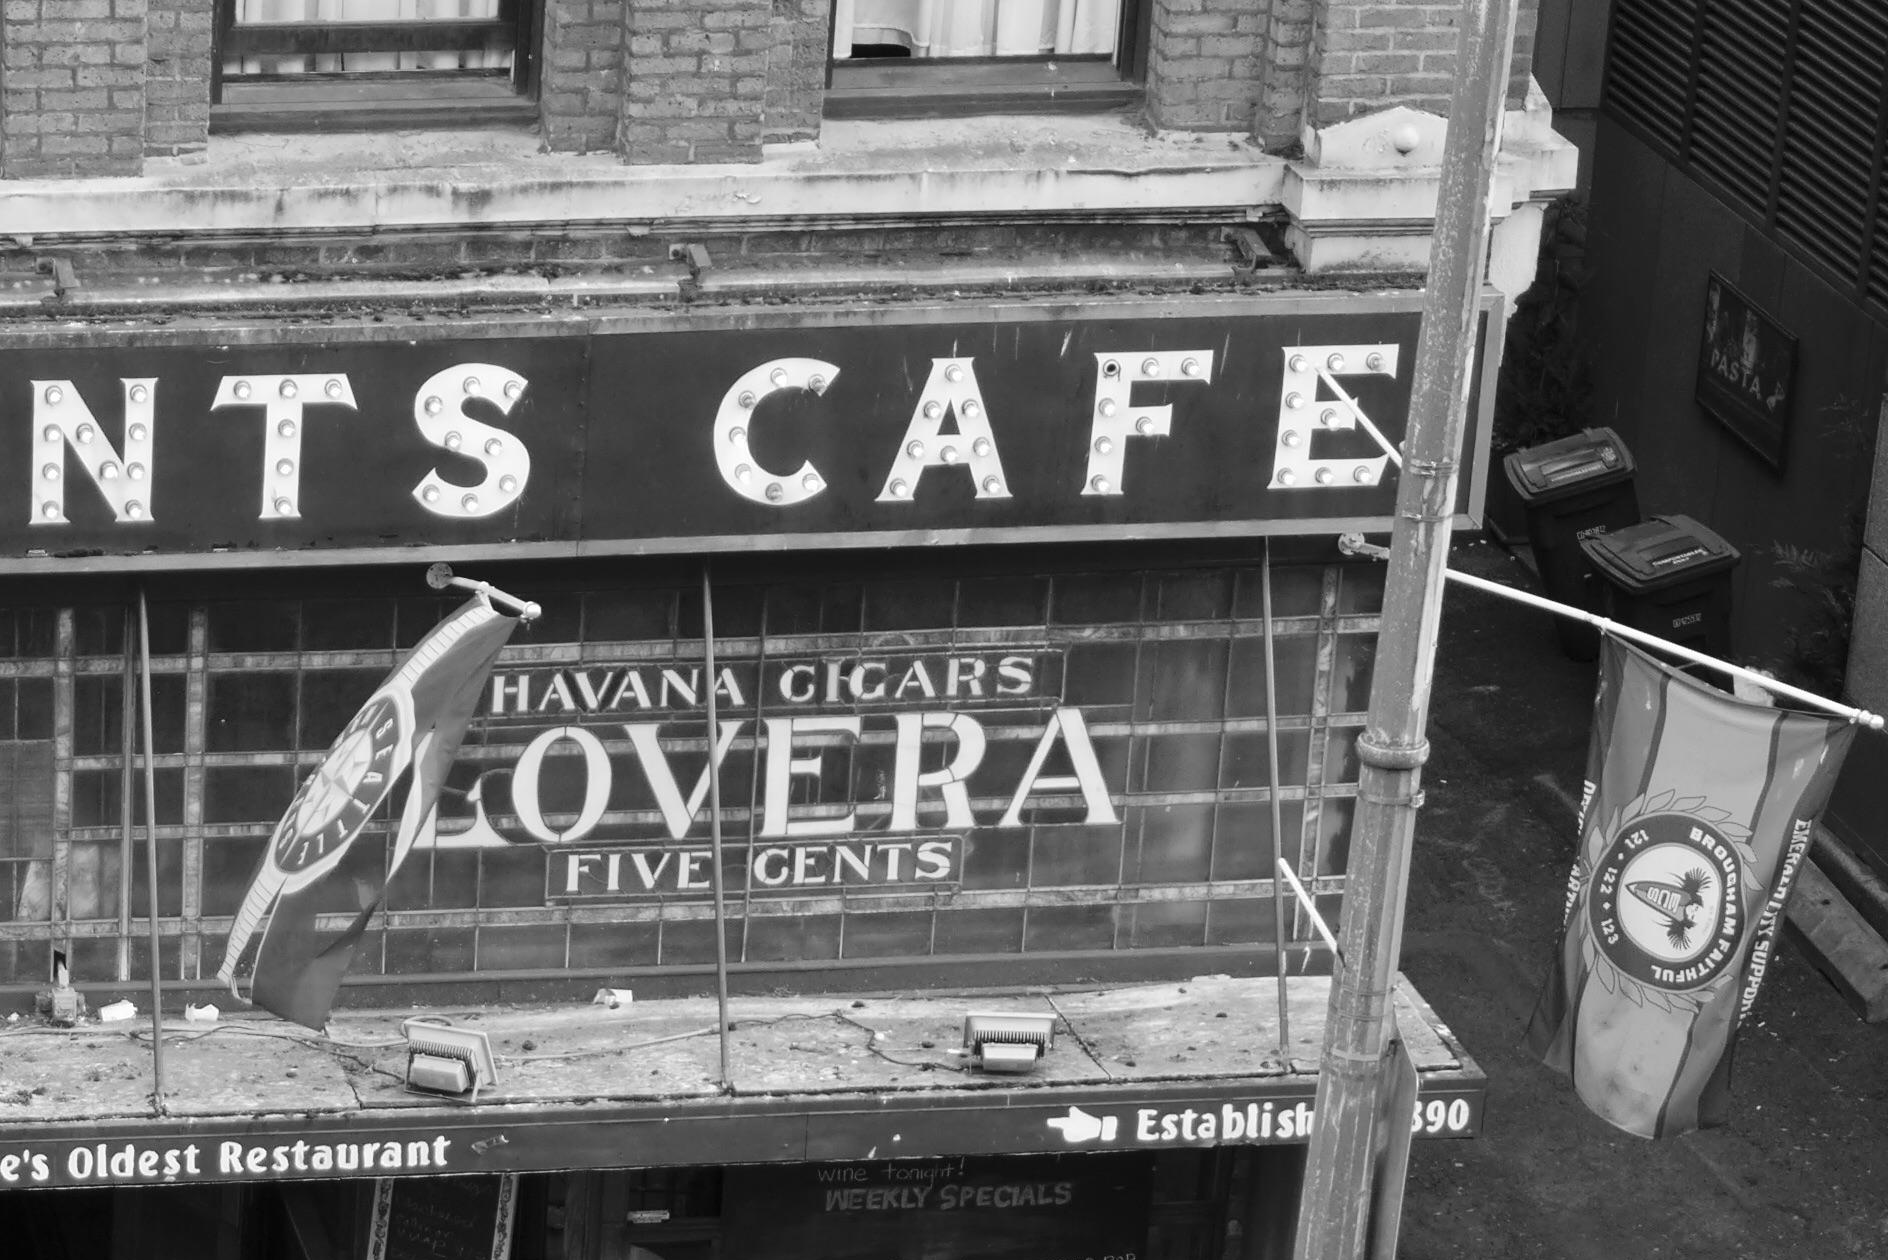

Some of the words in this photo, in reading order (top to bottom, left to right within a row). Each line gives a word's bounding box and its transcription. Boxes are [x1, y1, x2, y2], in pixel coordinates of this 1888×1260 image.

[1710, 348, 1762, 400] PASTA
[713, 341, 1399, 506] CAFE
[489, 665, 743, 713] HAVANA
[779, 655, 1035, 702] CIGARS
[1623, 828, 1649, 850] 121
[566, 850, 713, 892] FIVE
[754, 841, 953, 886] CENTS
[1598, 866, 1620, 895] 122
[1689, 827, 1738, 936] BROUGHAM
[1599, 917, 1620, 945] 123
[1649, 937, 1730, 984] FAITHFUL
[1137, 1101, 1316, 1142] Establish
[68, 1143, 201, 1182] Oldest
[219, 1135, 452, 1174] Restaurant
[817, 1166, 870, 1182] wine
[825, 1186, 932, 1212] WEEKLY
[939, 1182, 1073, 1210] SPECIALS
